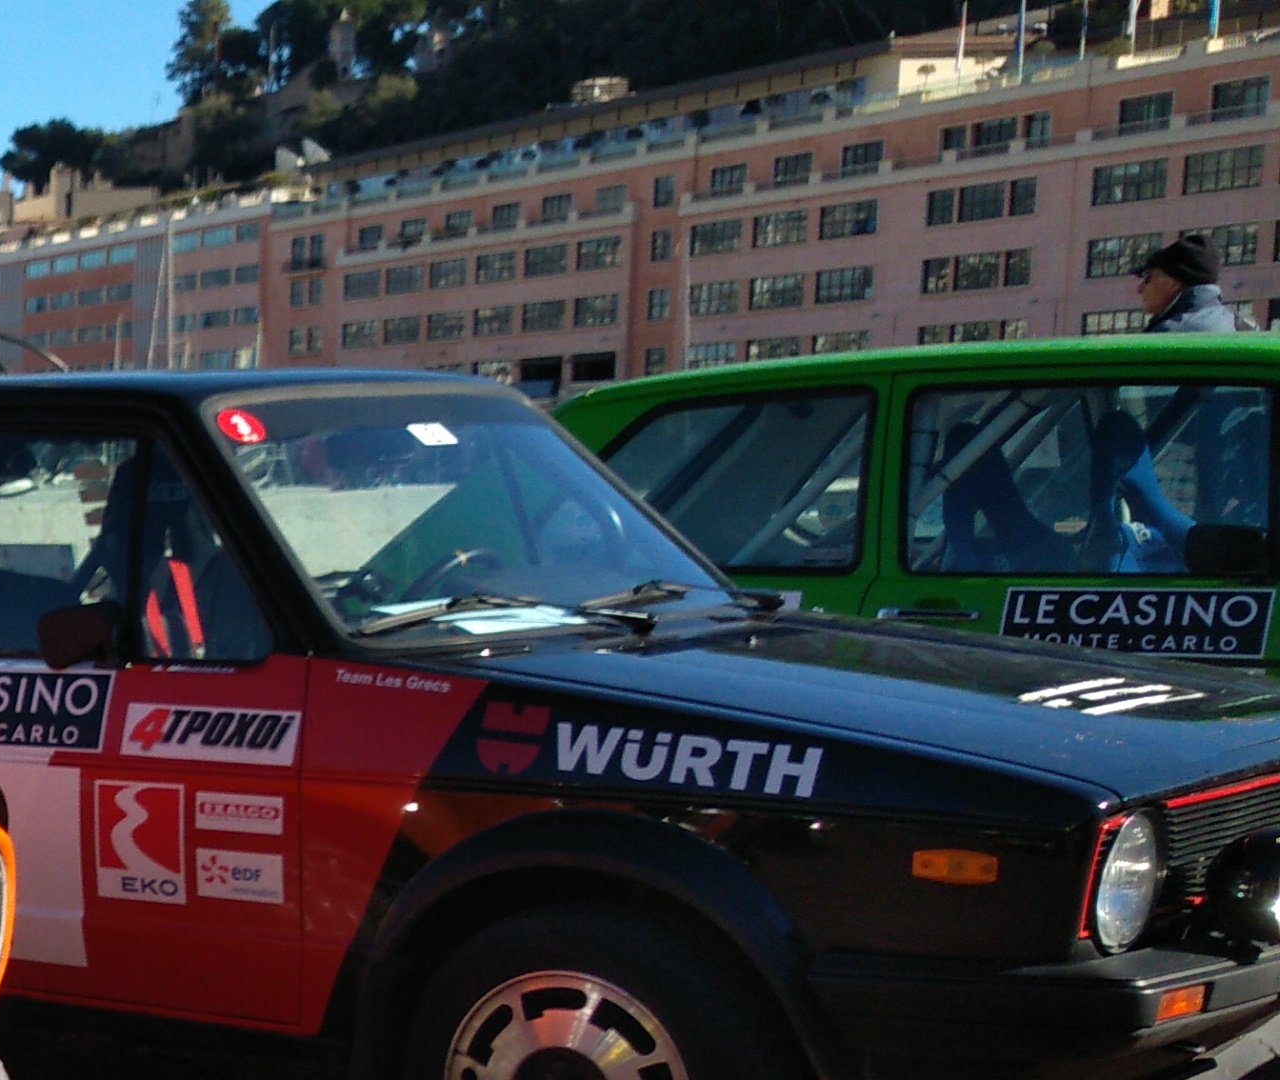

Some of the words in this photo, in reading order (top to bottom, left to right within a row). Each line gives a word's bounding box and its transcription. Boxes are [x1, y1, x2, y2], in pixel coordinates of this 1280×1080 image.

[1013, 594, 1060, 624] LE
[1069, 594, 1258, 627] CASINO
[336, 669, 373, 684] Team
[556, 721, 824, 798] WÜRTH
[121, 876, 178, 896] EKO
